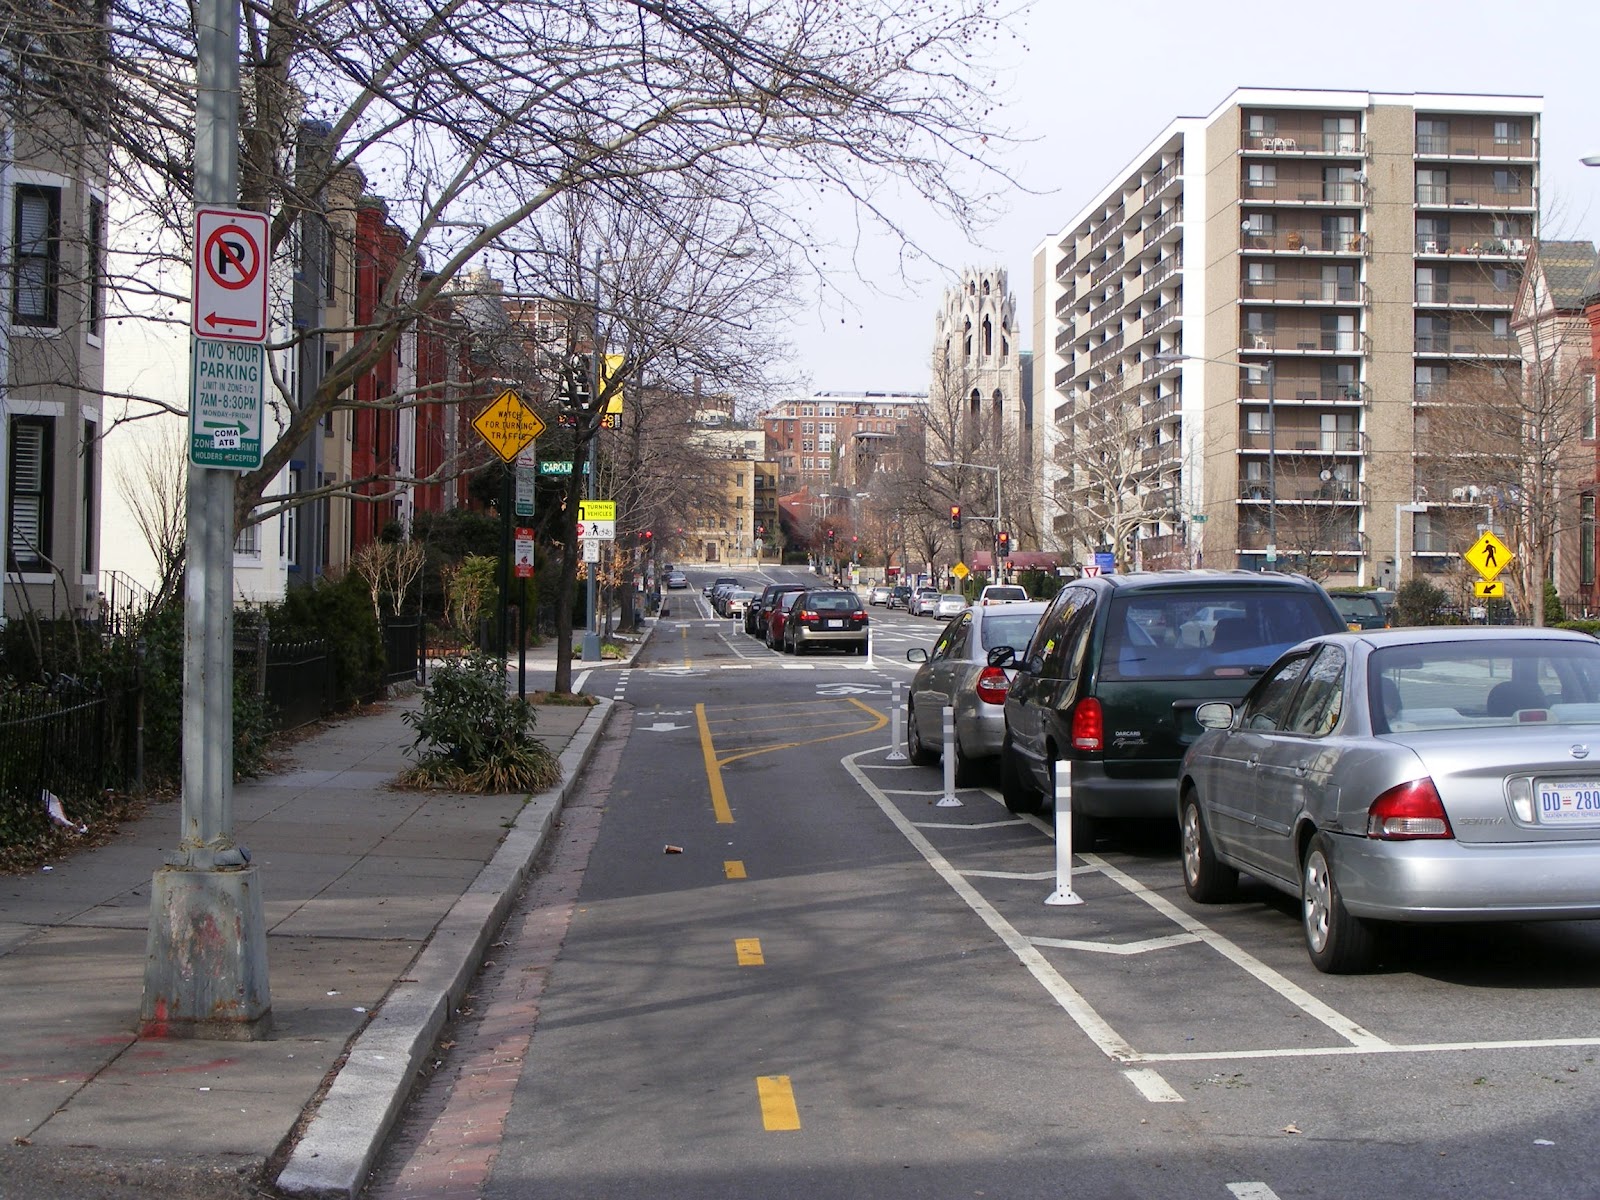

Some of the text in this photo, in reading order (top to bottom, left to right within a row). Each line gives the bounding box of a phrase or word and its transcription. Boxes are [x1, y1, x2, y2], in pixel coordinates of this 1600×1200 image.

[200, 342, 258, 363] TWO HOUR
[200, 361, 258, 382] PARKING
[202, 381, 255, 394] LIMIT IN ZONE 1/2
[202, 409, 253, 419] MONDAY-FRIDAY
[498, 411, 523, 419] WATCH
[485, 421, 533, 431] FOR TURNING
[491, 431, 526, 441] TRAFFIC
[218, 439, 235, 447] ATB
[240, 442, 259, 452] RMIT
[195, 451, 257, 463] HOLDERS EXCEPTED
[1542, 792, 1561, 811] DD
[1457, 817, 1507, 825] SENTRA
